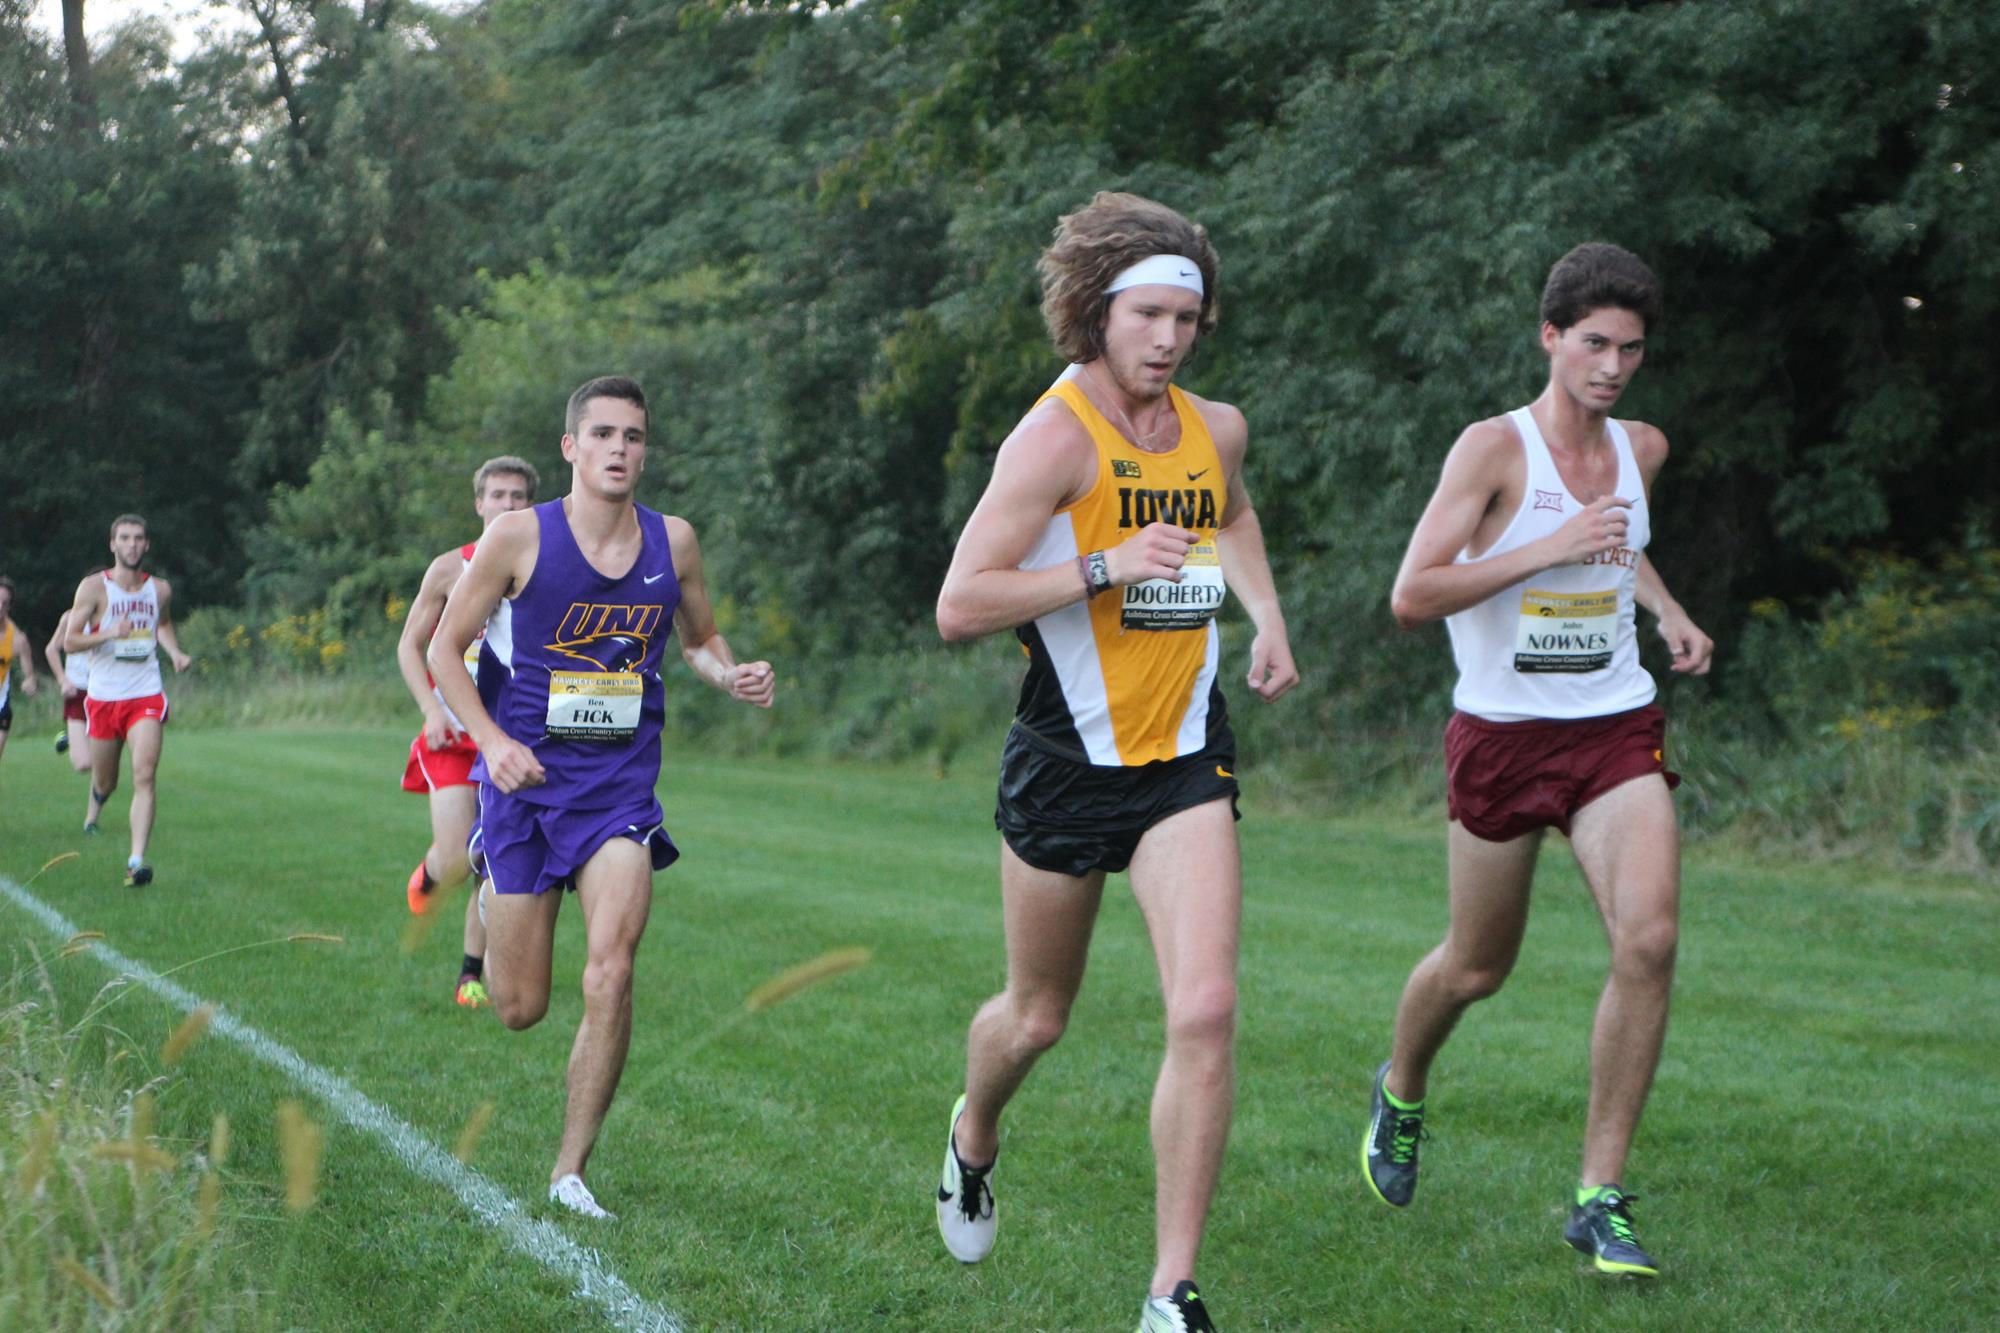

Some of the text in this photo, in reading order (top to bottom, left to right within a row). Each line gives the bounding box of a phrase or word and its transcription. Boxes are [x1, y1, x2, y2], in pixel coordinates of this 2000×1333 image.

[1118, 487, 1218, 529] IOWA
[1125, 585, 1225, 604] DOCHERTY
[112, 600, 154, 616] ILLINOIS
[556, 602, 663, 645] UNI
[1527, 632, 1609, 651] NOWNES
[573, 709, 614, 723] FICK
[587, 727, 612, 737] Country
